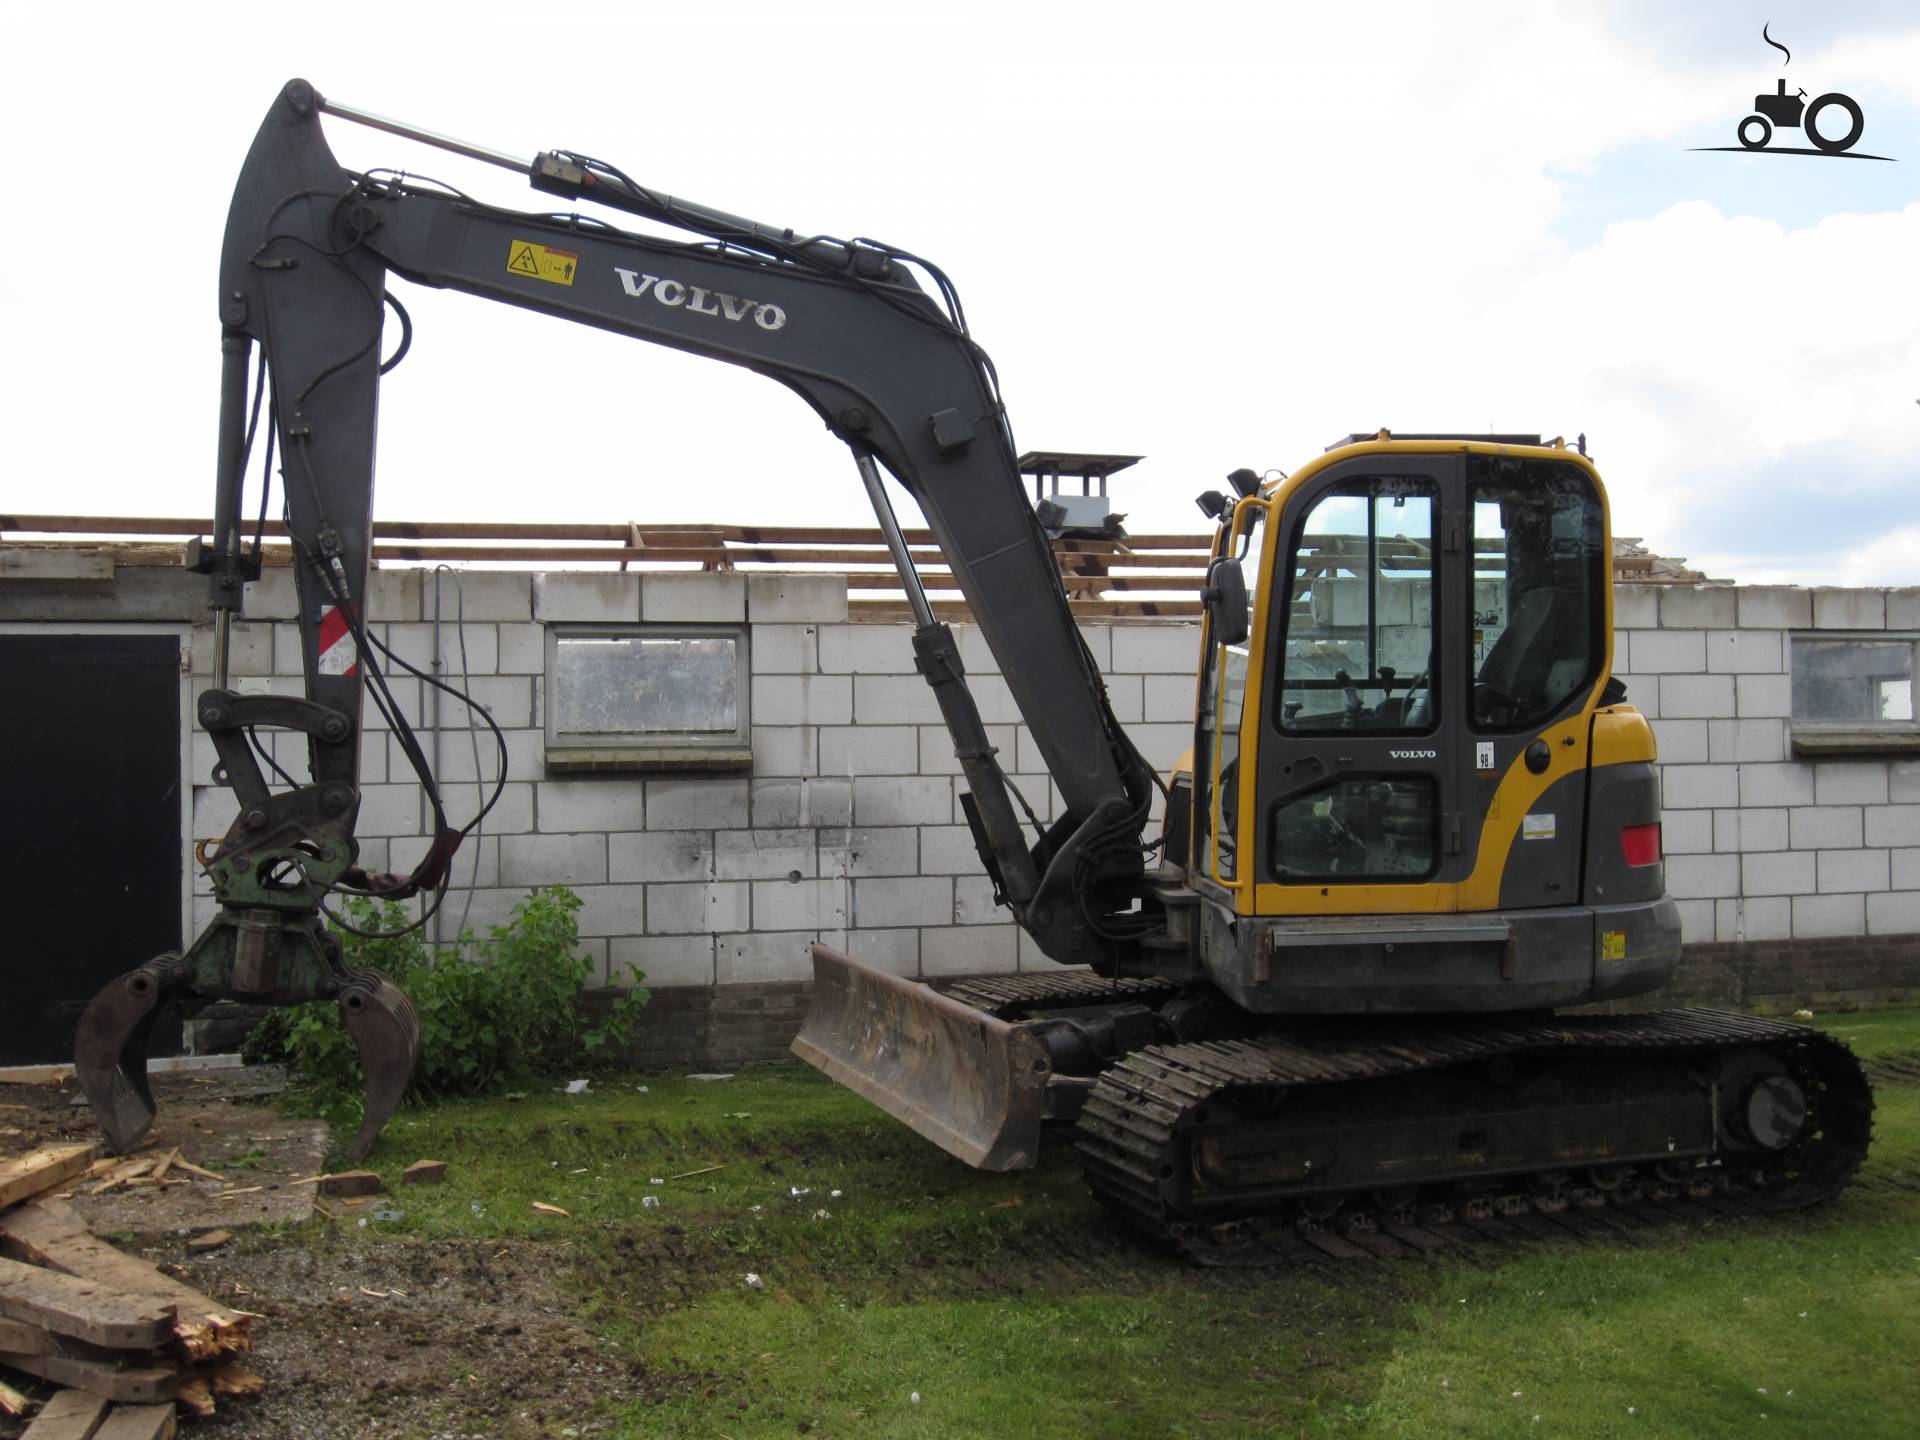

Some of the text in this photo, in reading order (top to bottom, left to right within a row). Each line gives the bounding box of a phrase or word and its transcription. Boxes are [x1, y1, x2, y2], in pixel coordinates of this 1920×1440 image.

[614, 267, 787, 330] VOLVO
[1389, 750, 1437, 759] VOLVO
[1480, 753, 1489, 768] 98
